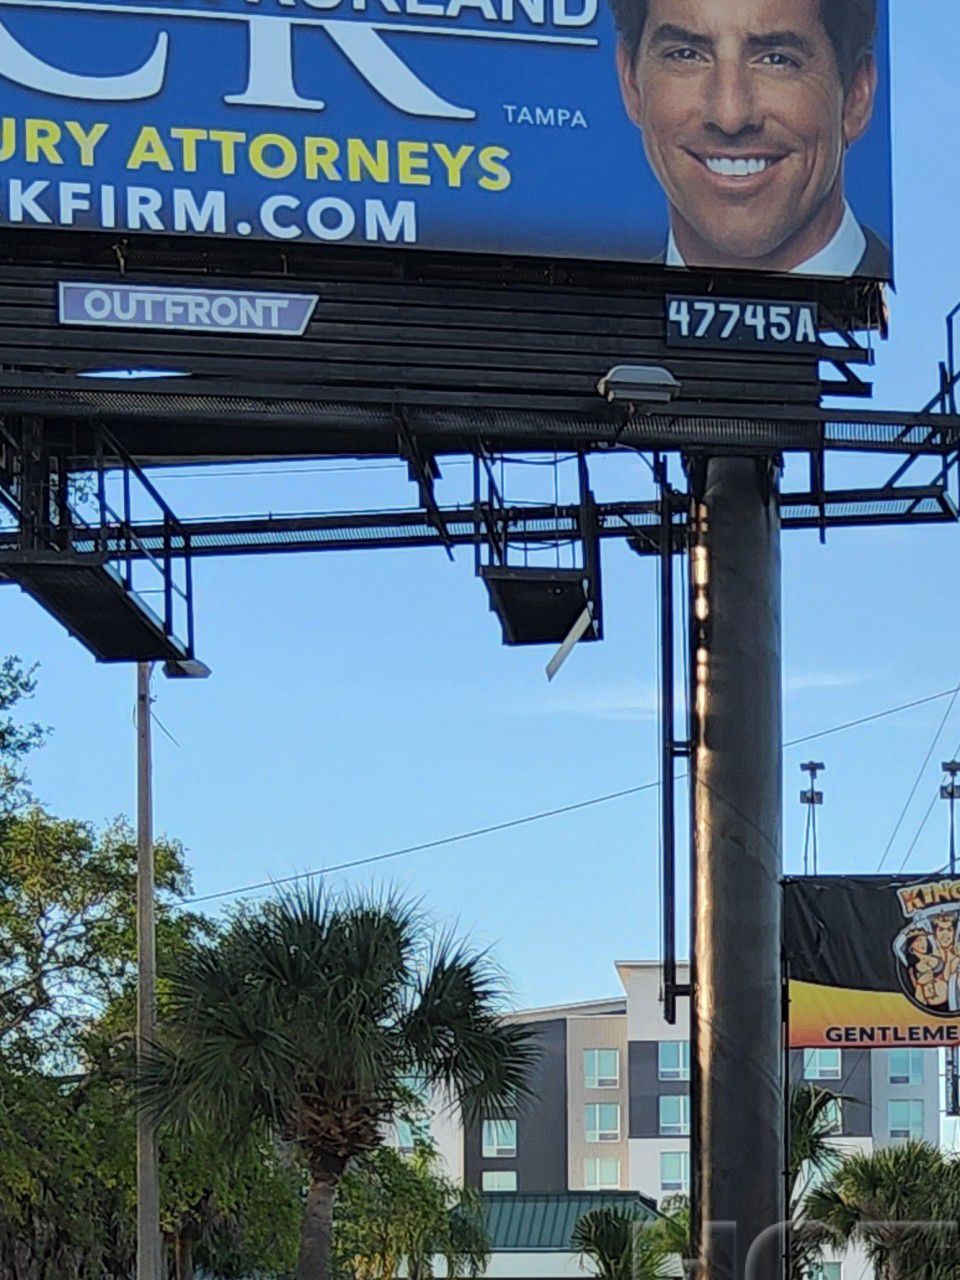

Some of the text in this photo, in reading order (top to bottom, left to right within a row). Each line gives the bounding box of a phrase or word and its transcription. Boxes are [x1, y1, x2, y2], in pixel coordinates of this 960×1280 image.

[503, 105, 588, 128] TAMPA
[126, 126, 511, 191] ATTORNEYS
[9, 178, 417, 243] KFIRM.COM
[84, 289, 289, 328] OUTFRONT
[669, 301, 816, 343] 47745A
